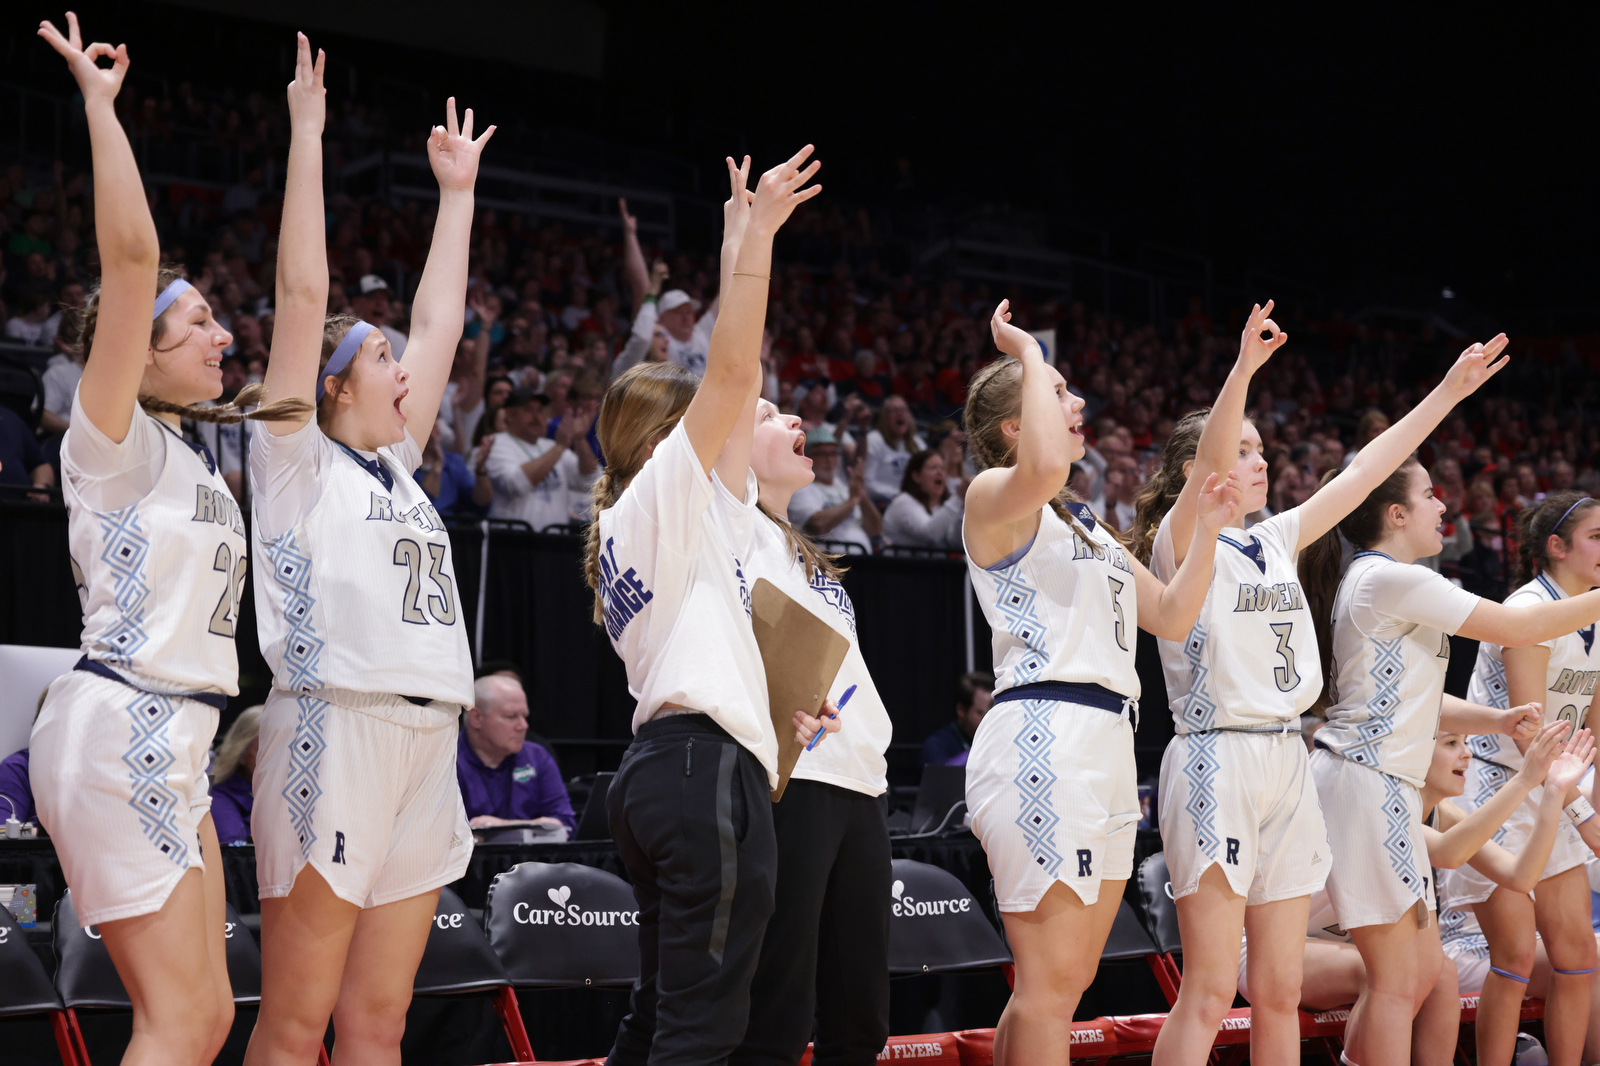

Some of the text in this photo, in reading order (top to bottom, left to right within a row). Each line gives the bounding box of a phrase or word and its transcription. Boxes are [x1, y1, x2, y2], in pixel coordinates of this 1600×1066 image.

[191, 484, 246, 540] ROVE
[393, 538, 456, 626] 23
[1107, 575, 1129, 652] 5
[1269, 622, 1301, 692] 3
[1548, 668, 1600, 695] ROVE
[332, 831, 346, 865] R
[1226, 837, 1240, 865] R
[1077, 849, 1093, 877] R
[892, 896, 971, 917] eSource
[1219, 1017, 1250, 1030] FLYER
[892, 1042, 943, 1060] FLYERS
